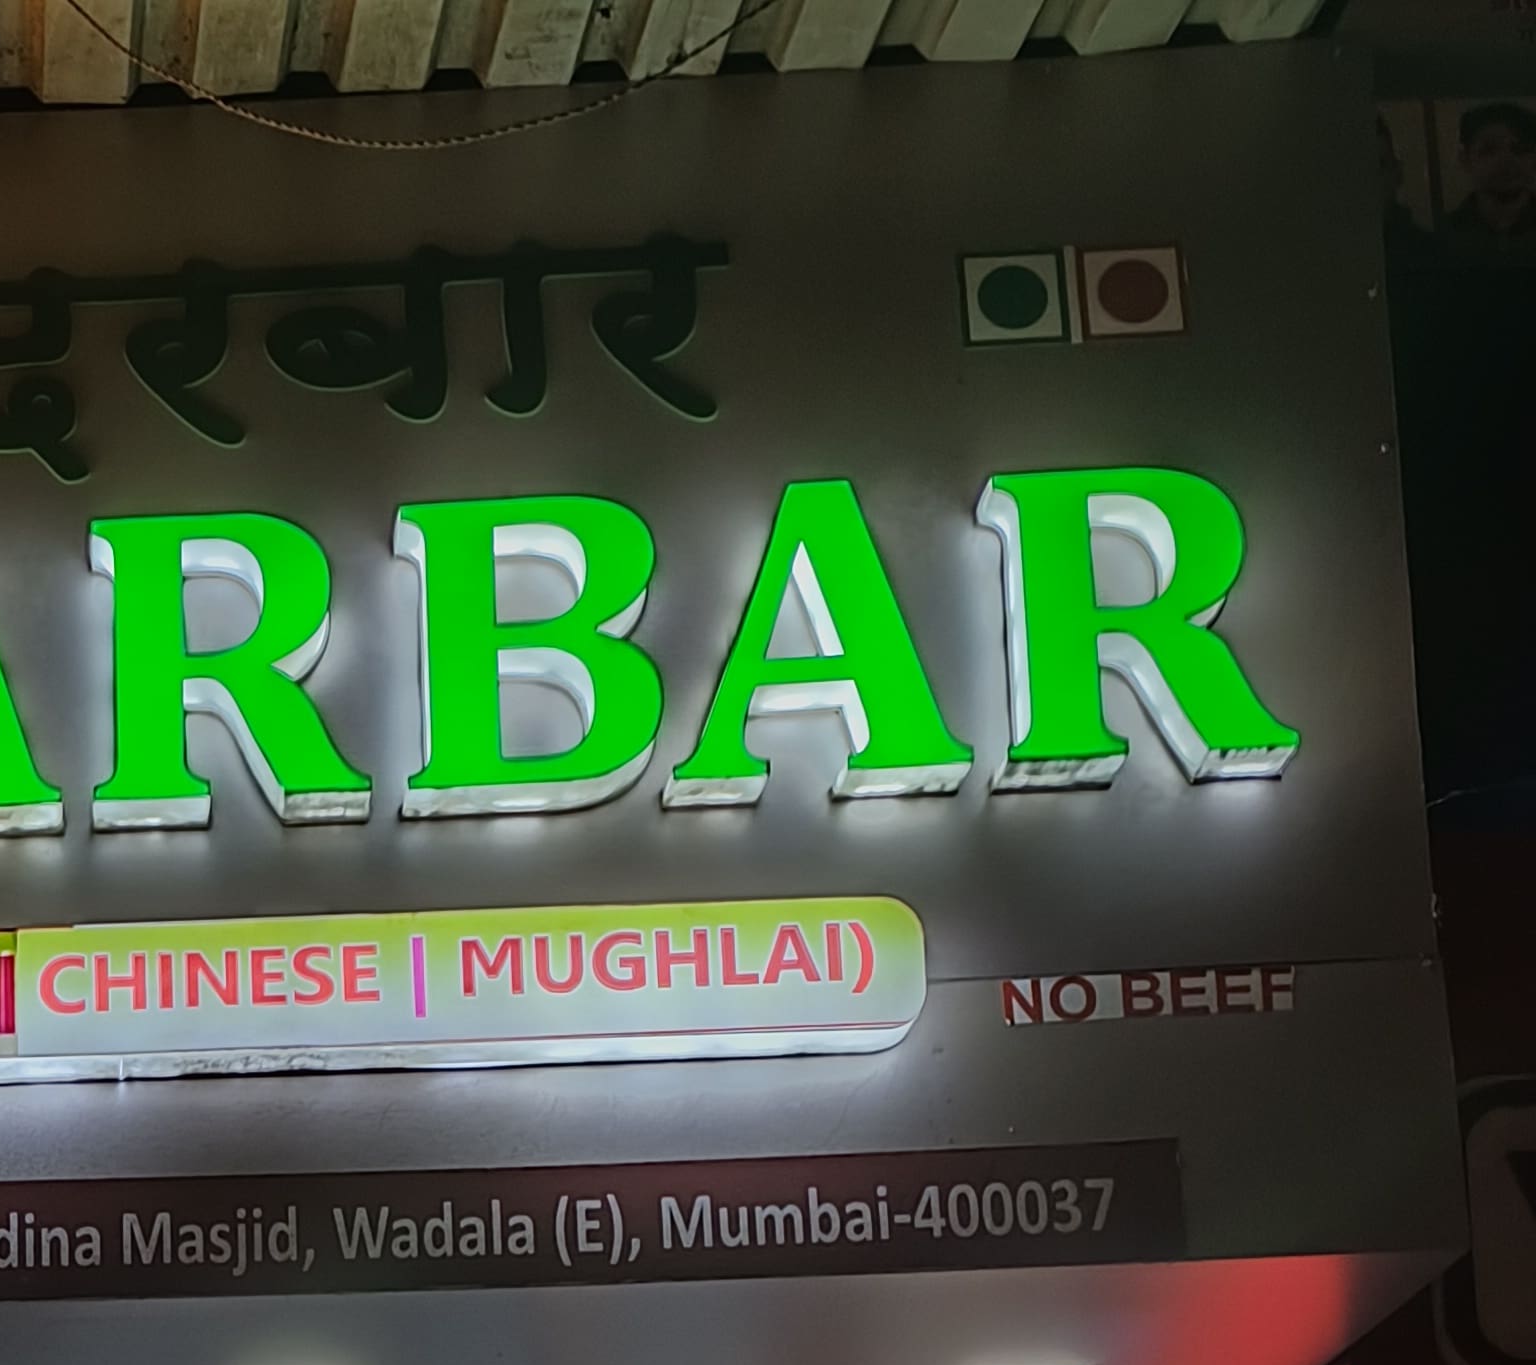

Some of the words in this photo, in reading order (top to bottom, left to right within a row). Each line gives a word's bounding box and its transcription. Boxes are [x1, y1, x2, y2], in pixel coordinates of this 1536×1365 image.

[38, 943, 381, 1015] CHINESE
[460, 920, 875, 998] MUGHLAI)
[1001, 975, 1097, 1024] NO
[1120, 965, 1295, 1017] BEEF
[120, 1205, 317, 1277] Masjid,
[333, 1200, 536, 1262] Wadala
[554, 1193, 642, 1267] (E),
[661, 1176, 1116, 1252] Mumbai-400037
